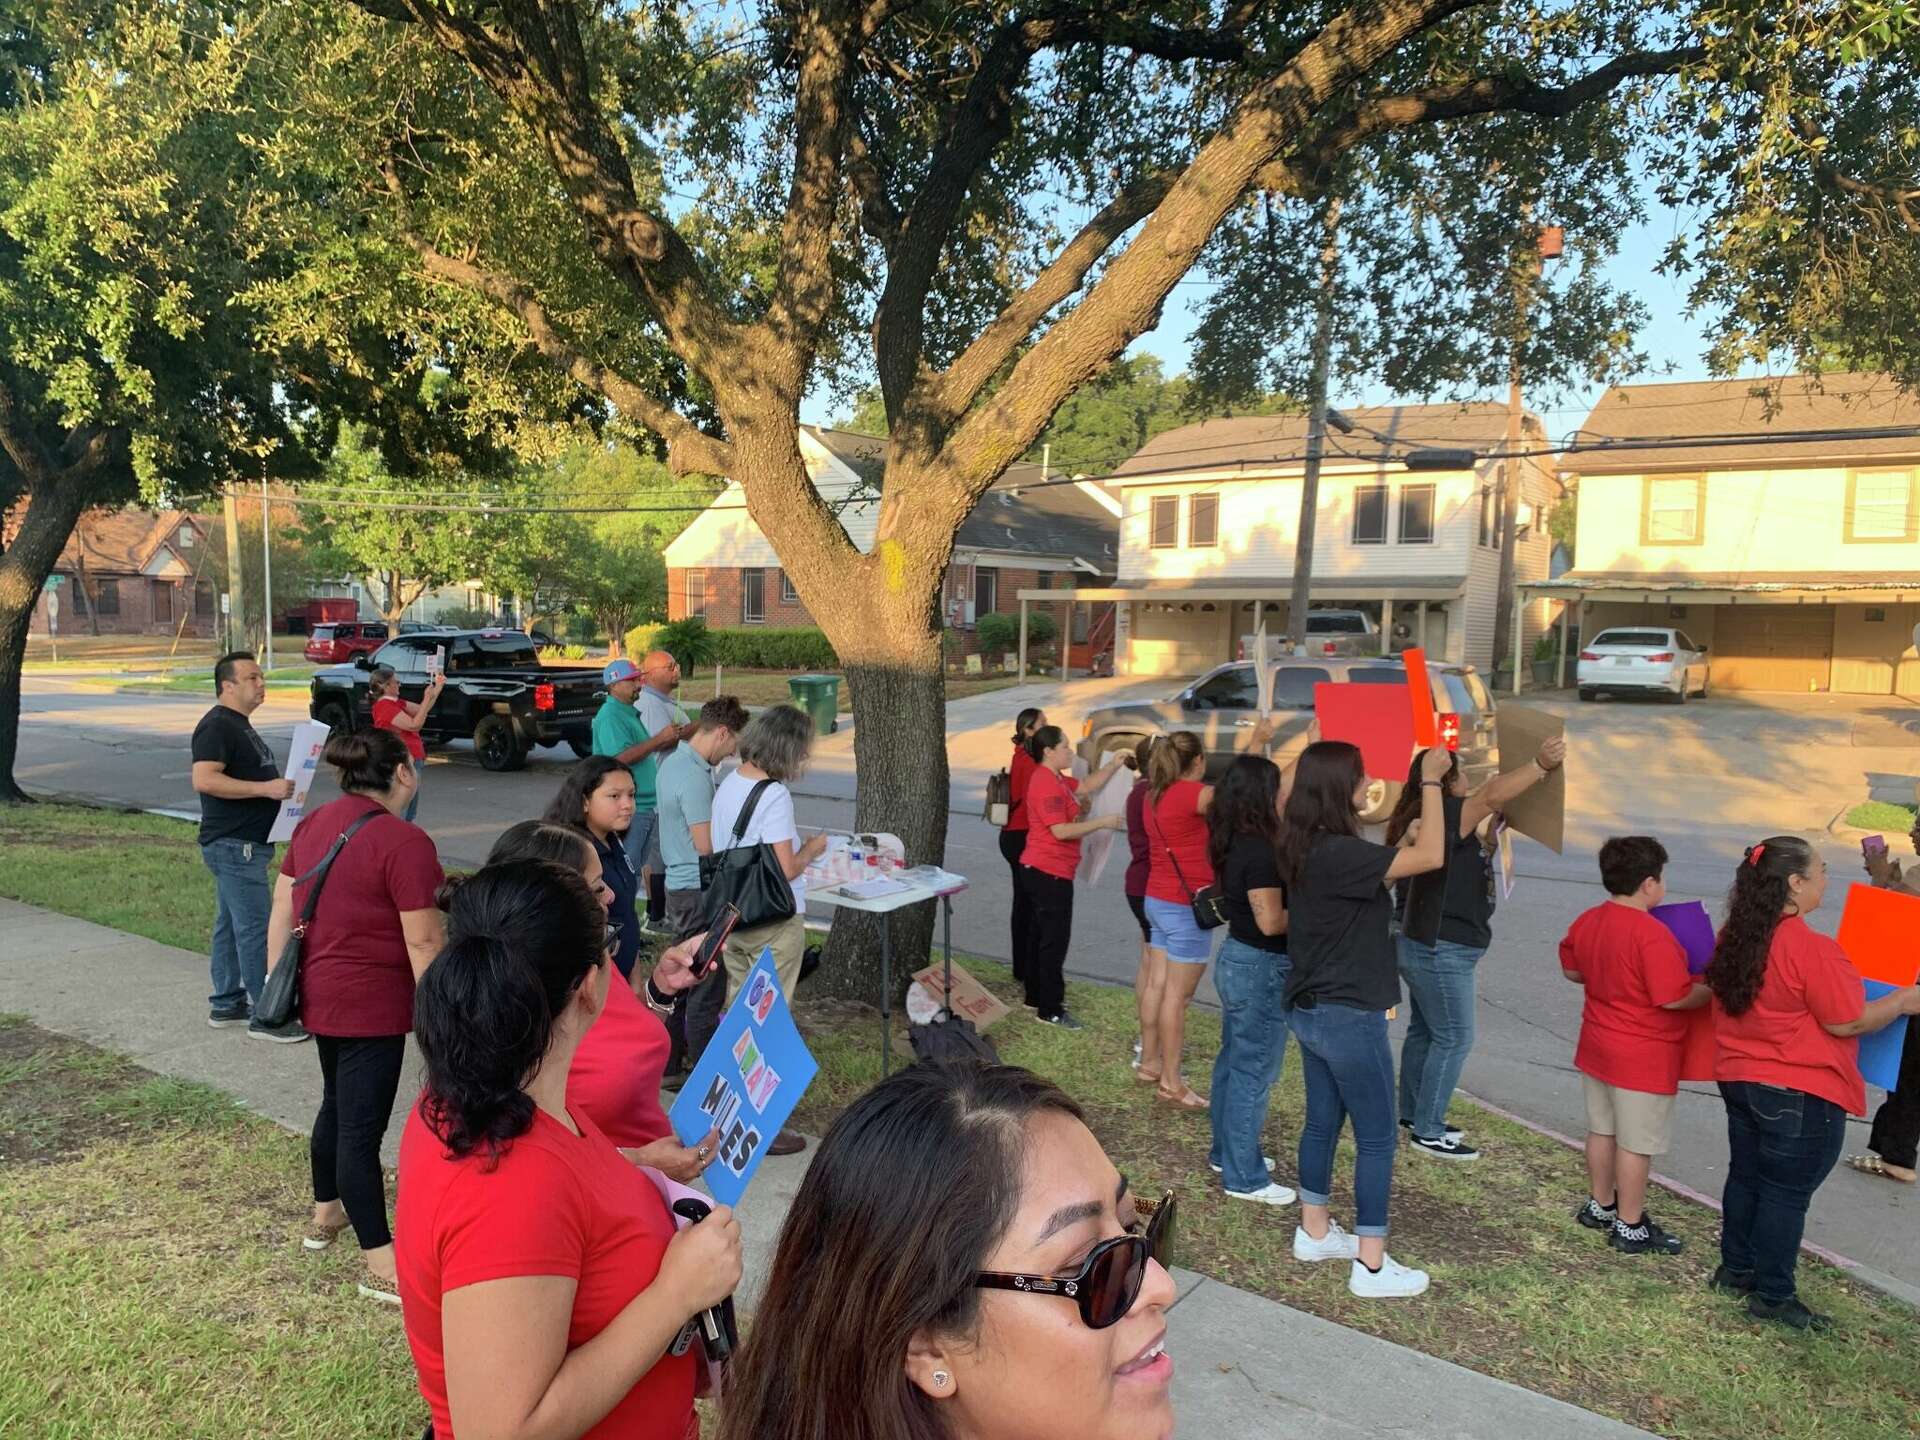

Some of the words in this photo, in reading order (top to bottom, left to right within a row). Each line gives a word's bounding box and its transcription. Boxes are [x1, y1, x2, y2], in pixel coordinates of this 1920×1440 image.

[747, 973, 775, 1022] GO
[734, 1030, 781, 1110] AWAY
[701, 1074, 760, 1172] MILES
